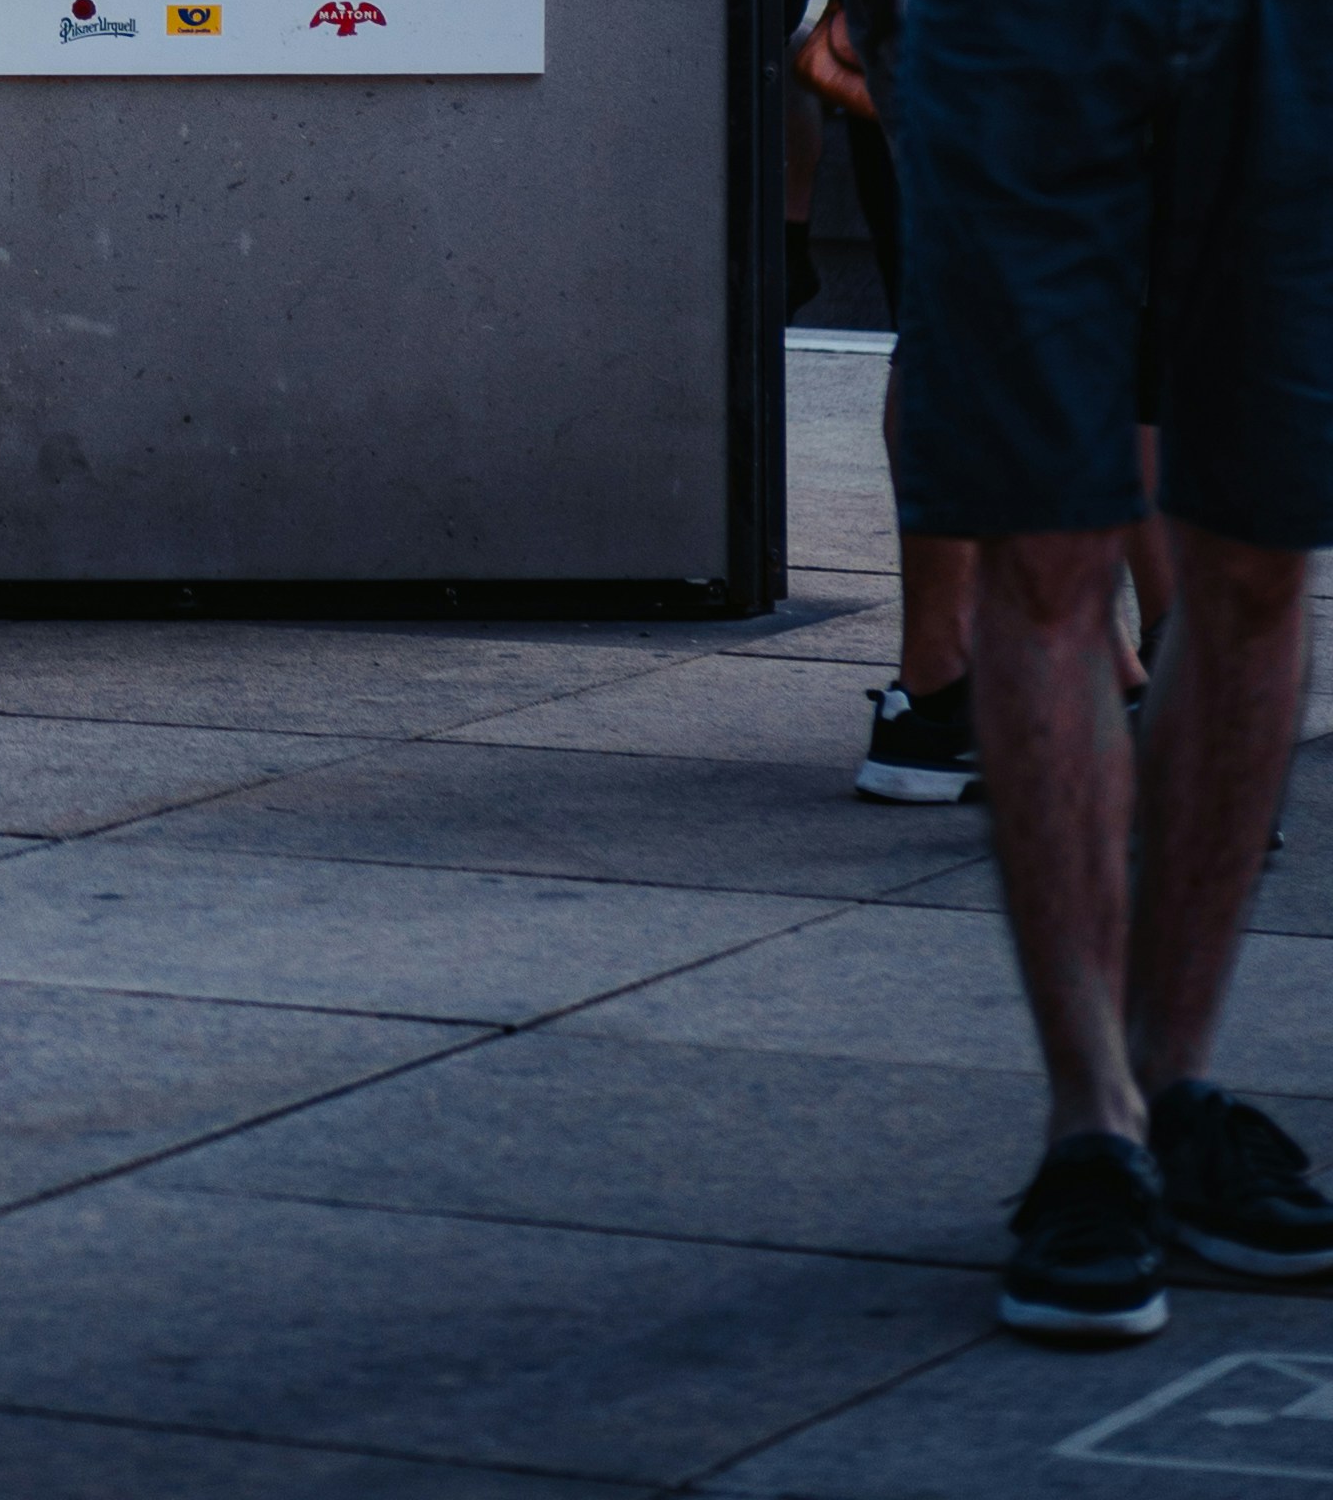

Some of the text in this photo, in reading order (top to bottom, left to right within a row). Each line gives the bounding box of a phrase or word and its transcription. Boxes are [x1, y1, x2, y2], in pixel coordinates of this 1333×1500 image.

[318, 9, 379, 20] MATTONI
[59, 16, 137, 44] Pilsner Urquell
